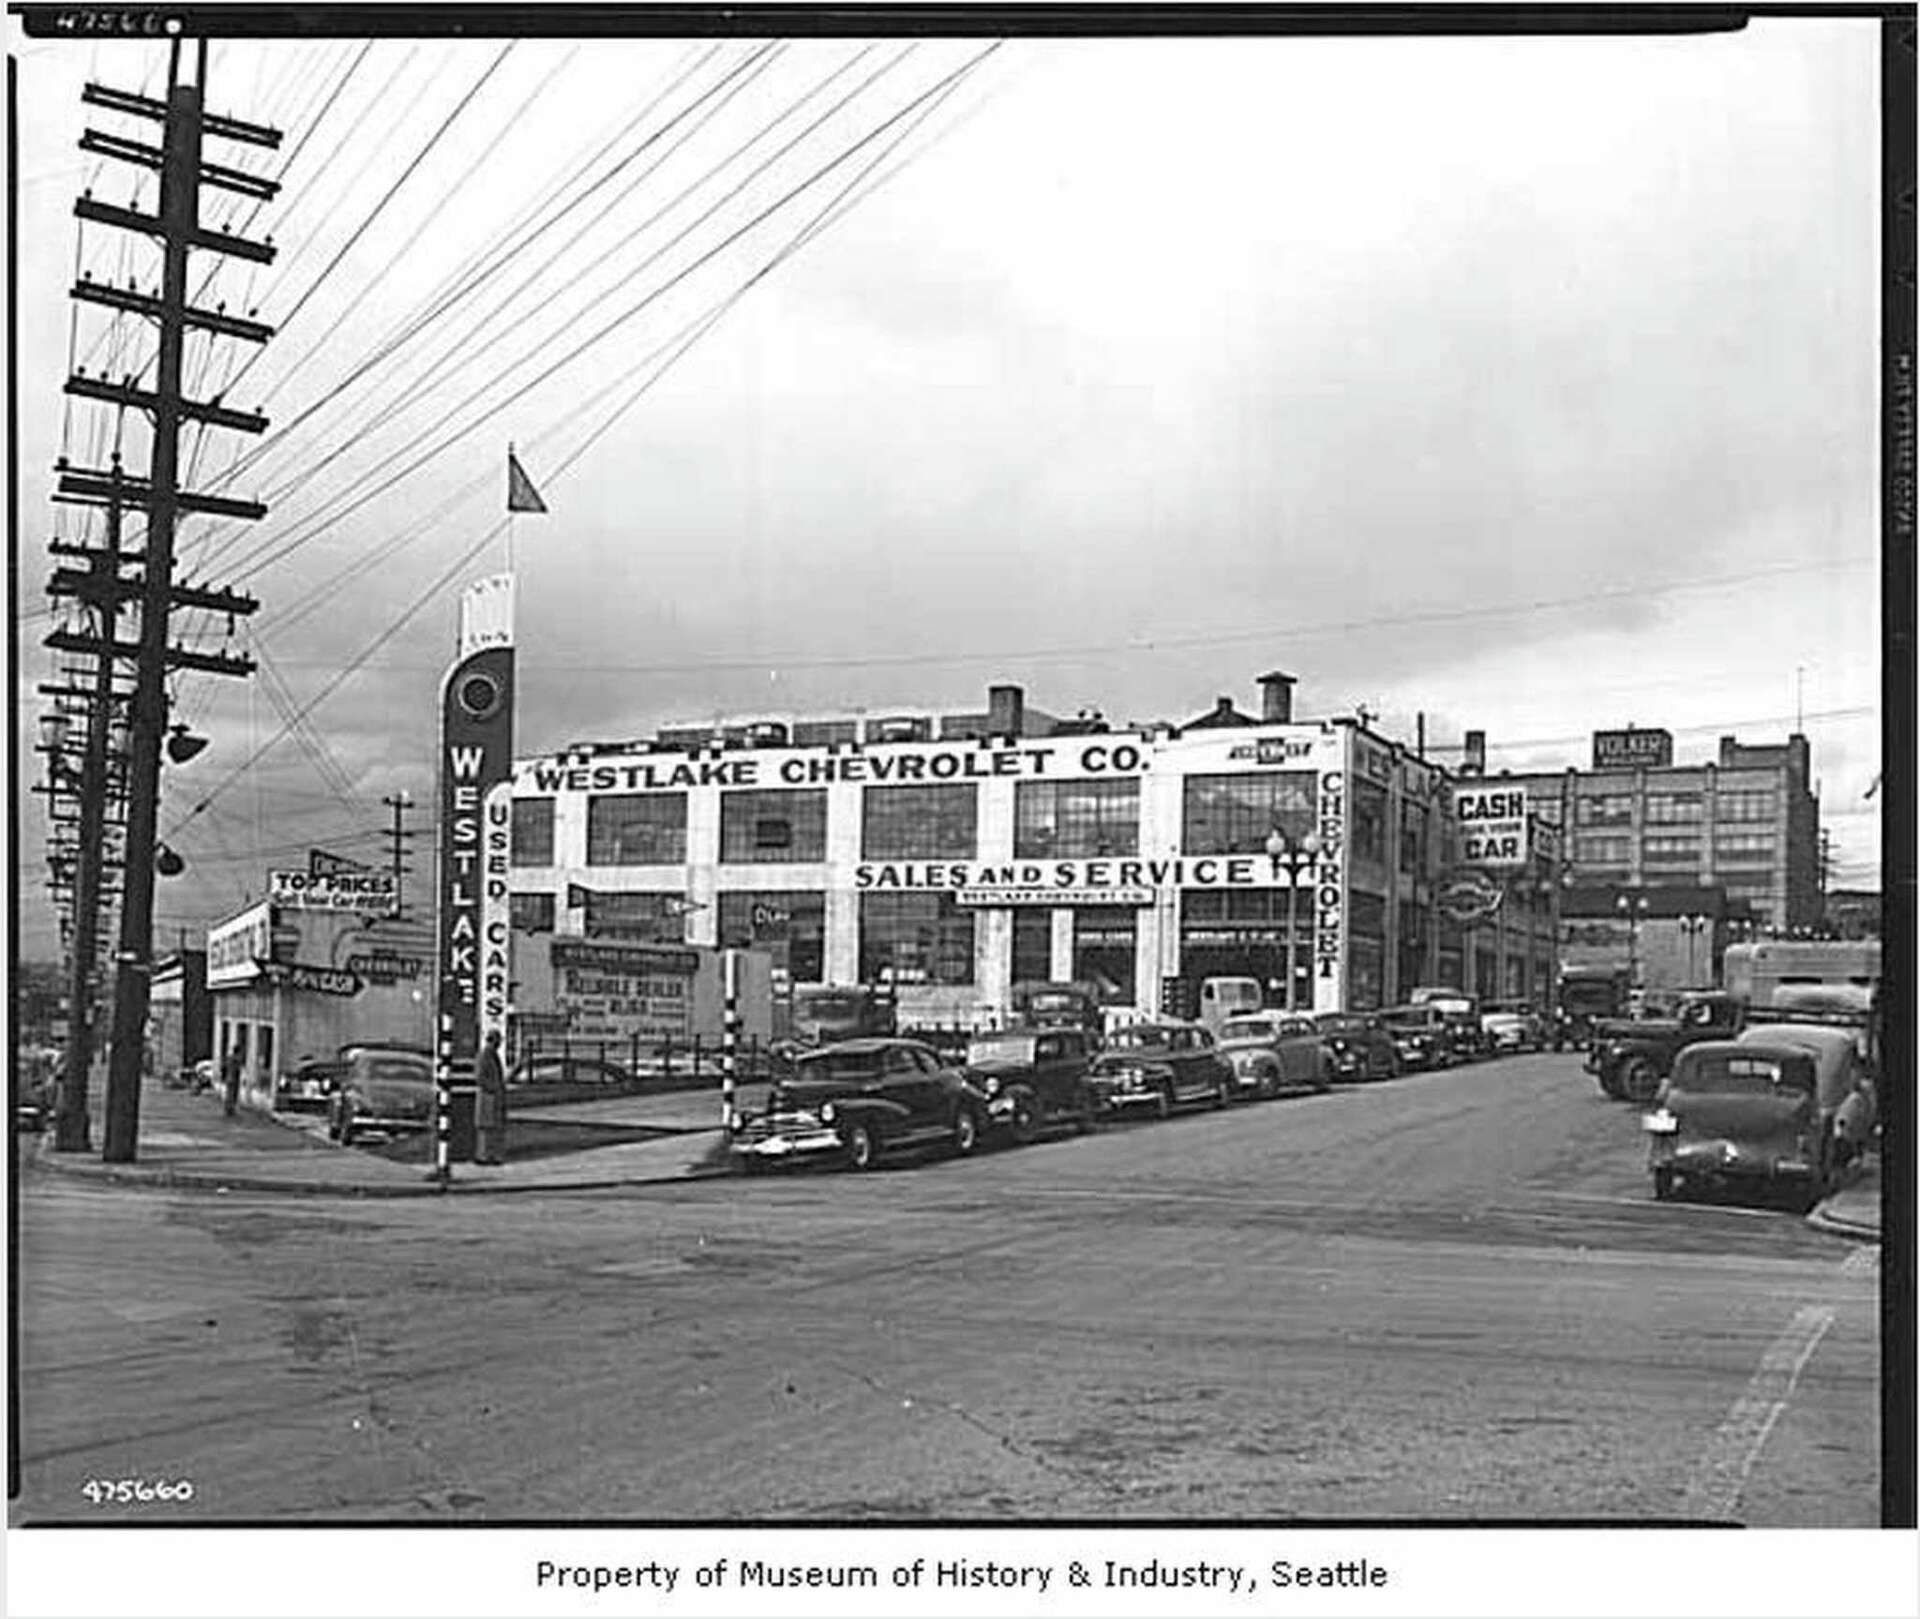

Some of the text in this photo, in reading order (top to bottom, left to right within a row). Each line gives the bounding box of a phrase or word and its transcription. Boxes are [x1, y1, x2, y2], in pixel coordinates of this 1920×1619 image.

[535, 745, 1150, 792] WESTLAKE CHEVROLET CO.
[1458, 791, 1523, 820] CASH
[1465, 837, 1518, 860] CAR
[325, 876, 393, 895] PRICES
[451, 746, 484, 1005] WESTLAKE
[854, 858, 1256, 889] SALES AND SERVICE
[1318, 771, 1342, 978] CHEVROLET
[486, 804, 508, 1017] USED CARS
